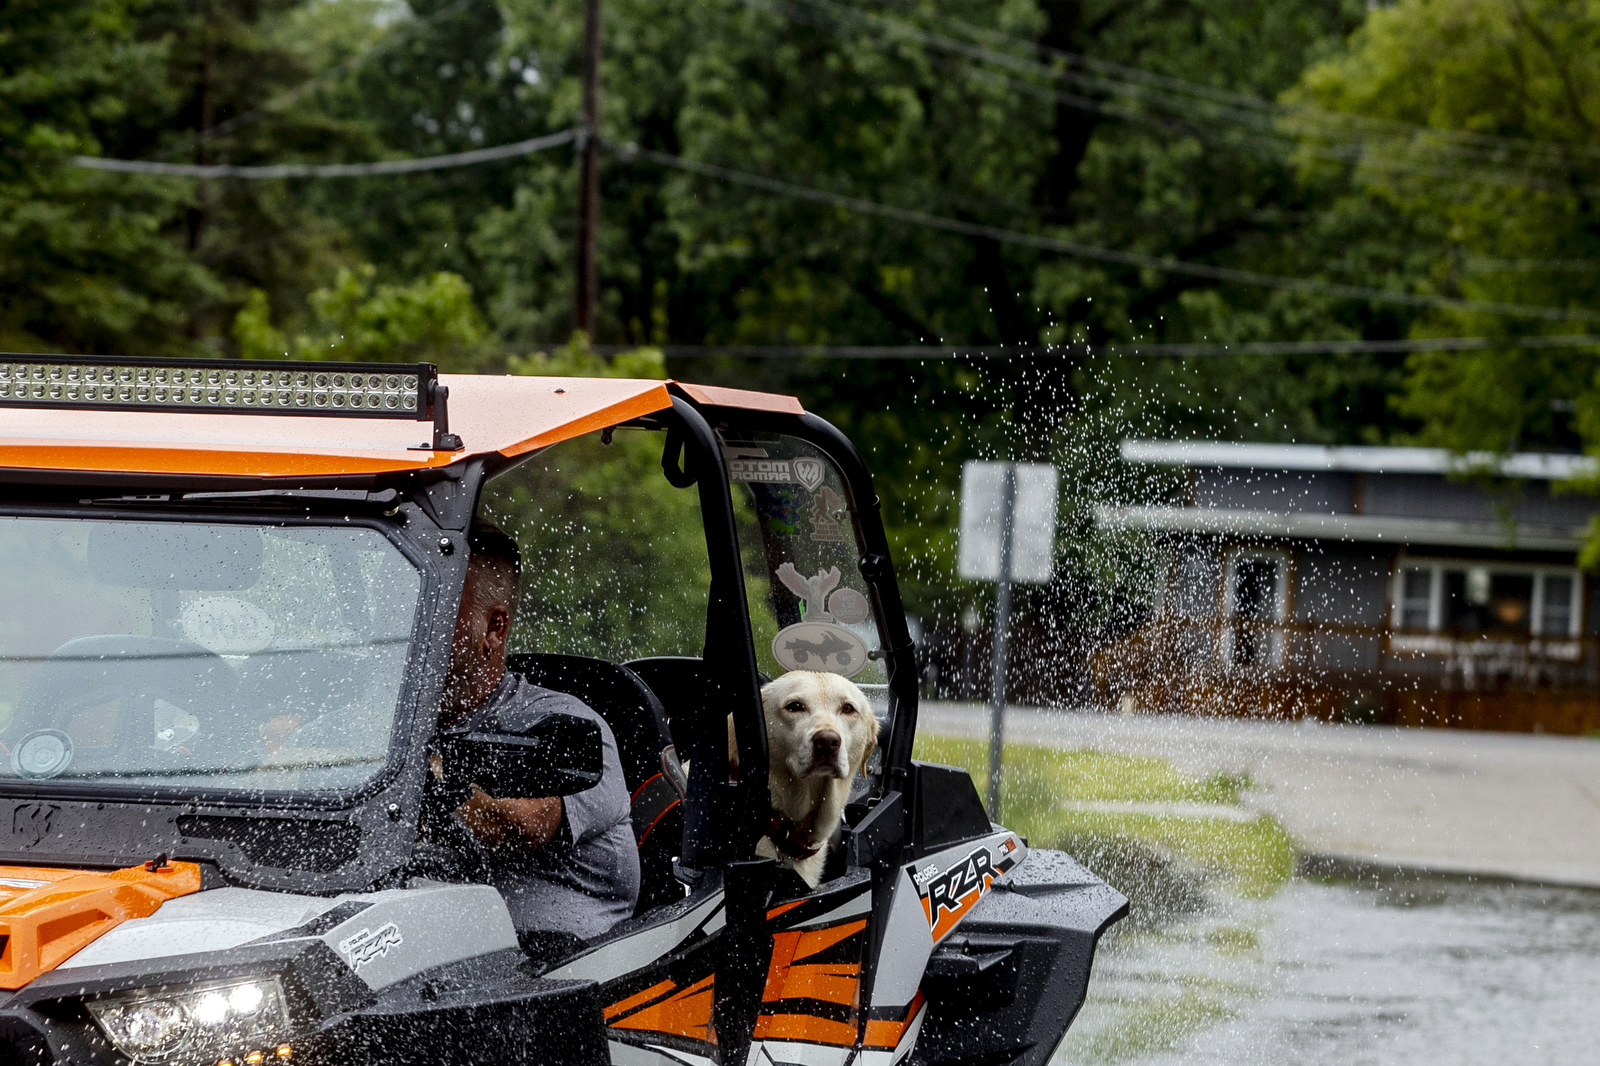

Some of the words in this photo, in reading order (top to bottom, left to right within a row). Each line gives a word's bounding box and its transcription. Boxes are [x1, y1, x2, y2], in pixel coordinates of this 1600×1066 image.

[913, 863, 939, 886] POLARIS
[927, 845, 1004, 933] RZR
[349, 922, 404, 973] RZR
